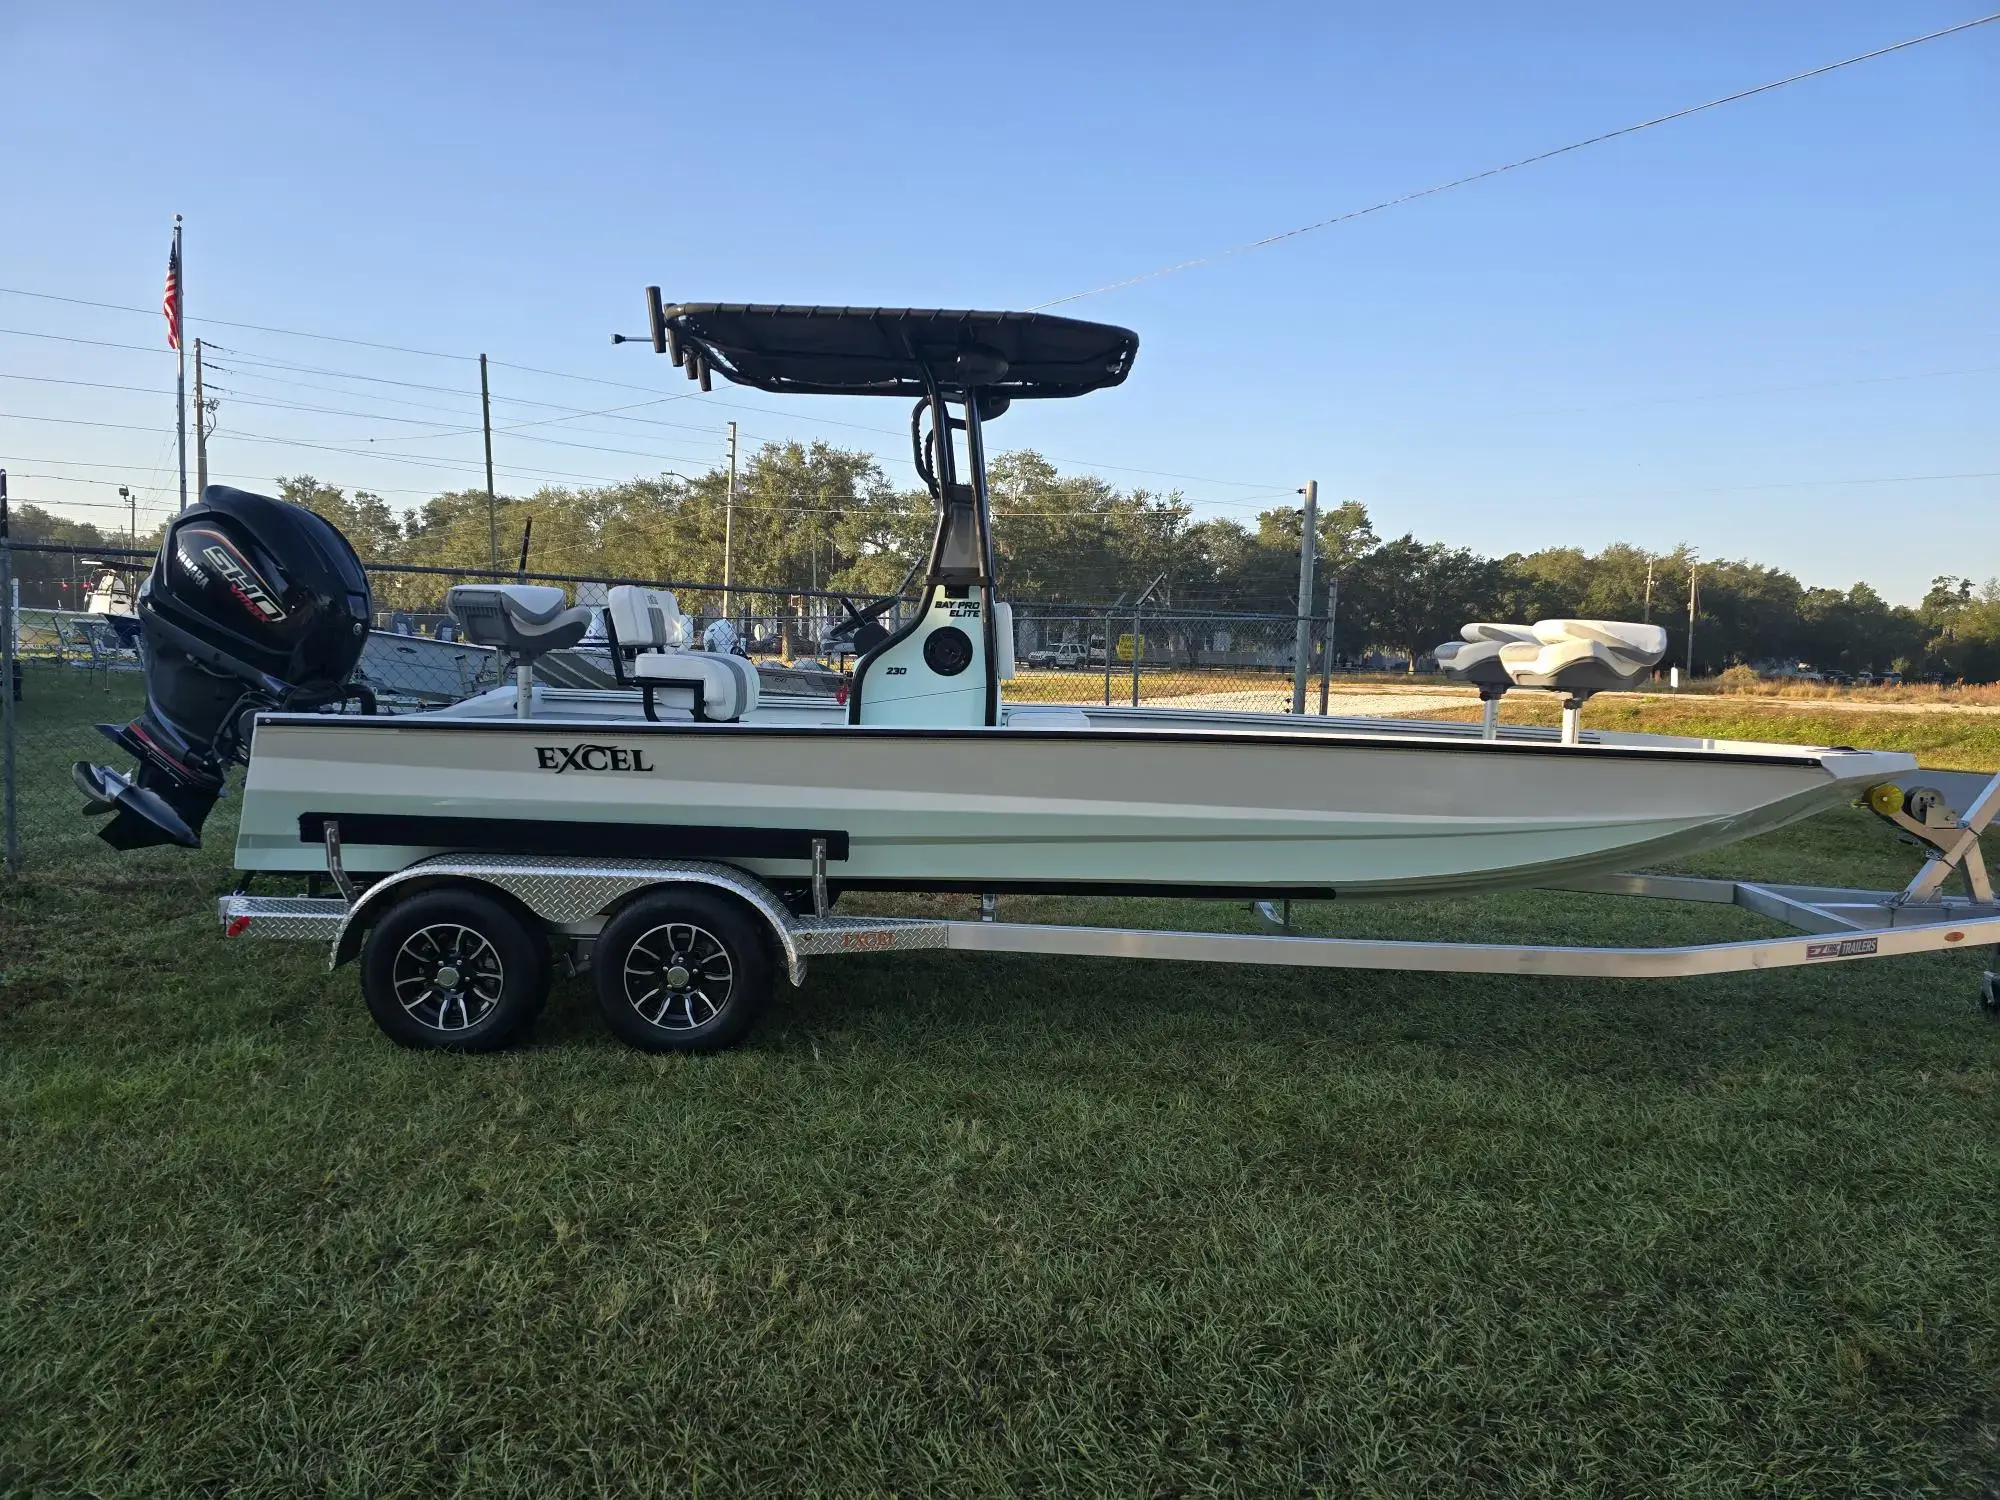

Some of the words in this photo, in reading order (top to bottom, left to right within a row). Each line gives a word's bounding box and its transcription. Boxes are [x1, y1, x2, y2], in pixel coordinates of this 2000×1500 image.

[176, 547, 210, 590] YAMAHA
[203, 546, 288, 622] SHO
[934, 601, 957, 609] BAY
[957, 601, 981, 610] PRO
[949, 609, 981, 618] ELITE
[886, 667, 907, 675] 230
[534, 743, 654, 774] EXCEL
[1842, 940, 1876, 954] TRAILERS
